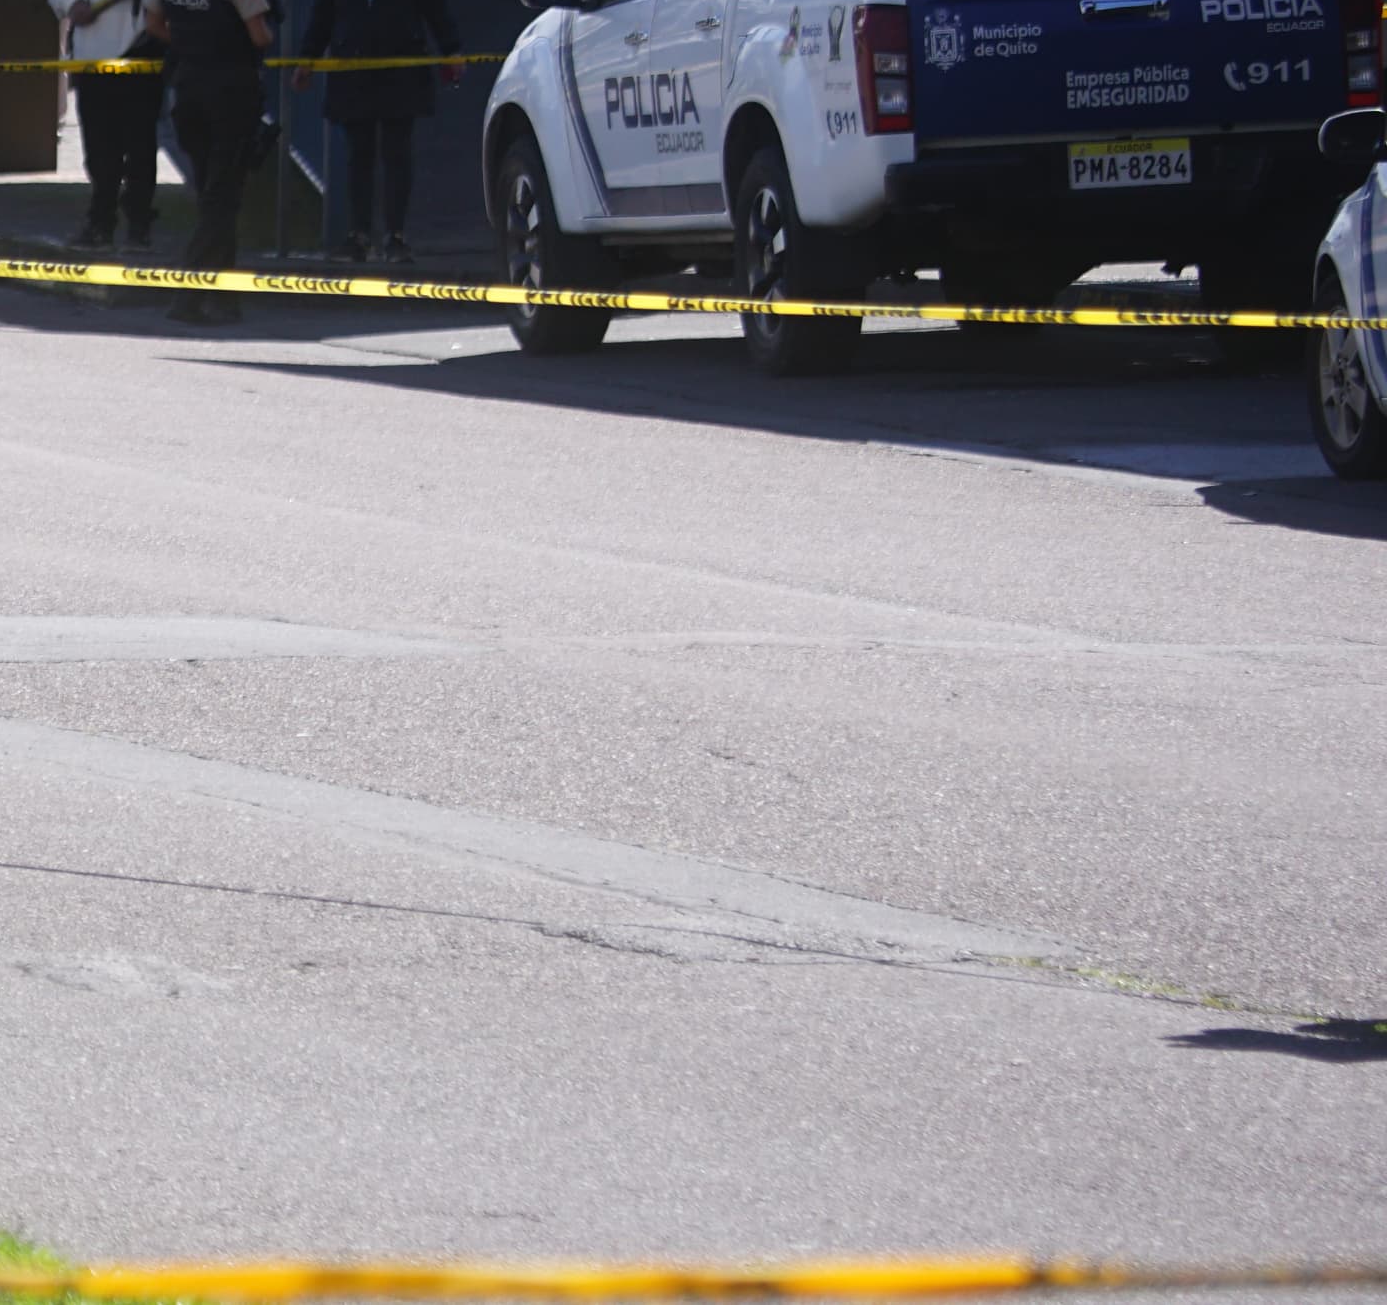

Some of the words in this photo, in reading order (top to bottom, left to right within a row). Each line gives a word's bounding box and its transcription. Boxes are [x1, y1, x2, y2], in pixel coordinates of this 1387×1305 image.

[972, 23, 1042, 41] Municipio
[1266, 20, 1324, 33] ECUADOR
[974, 44, 995, 57] de
[996, 41, 1038, 58] Quito
[1066, 70, 1130, 90] Empresa
[1133, 64, 1190, 84] Pública
[1247, 58, 1310, 85] 911
[1066, 84, 1190, 109] EMSEGURIDAD
[834, 111, 857, 135] 911
[1073, 153, 1188, 184] PMA-8284
